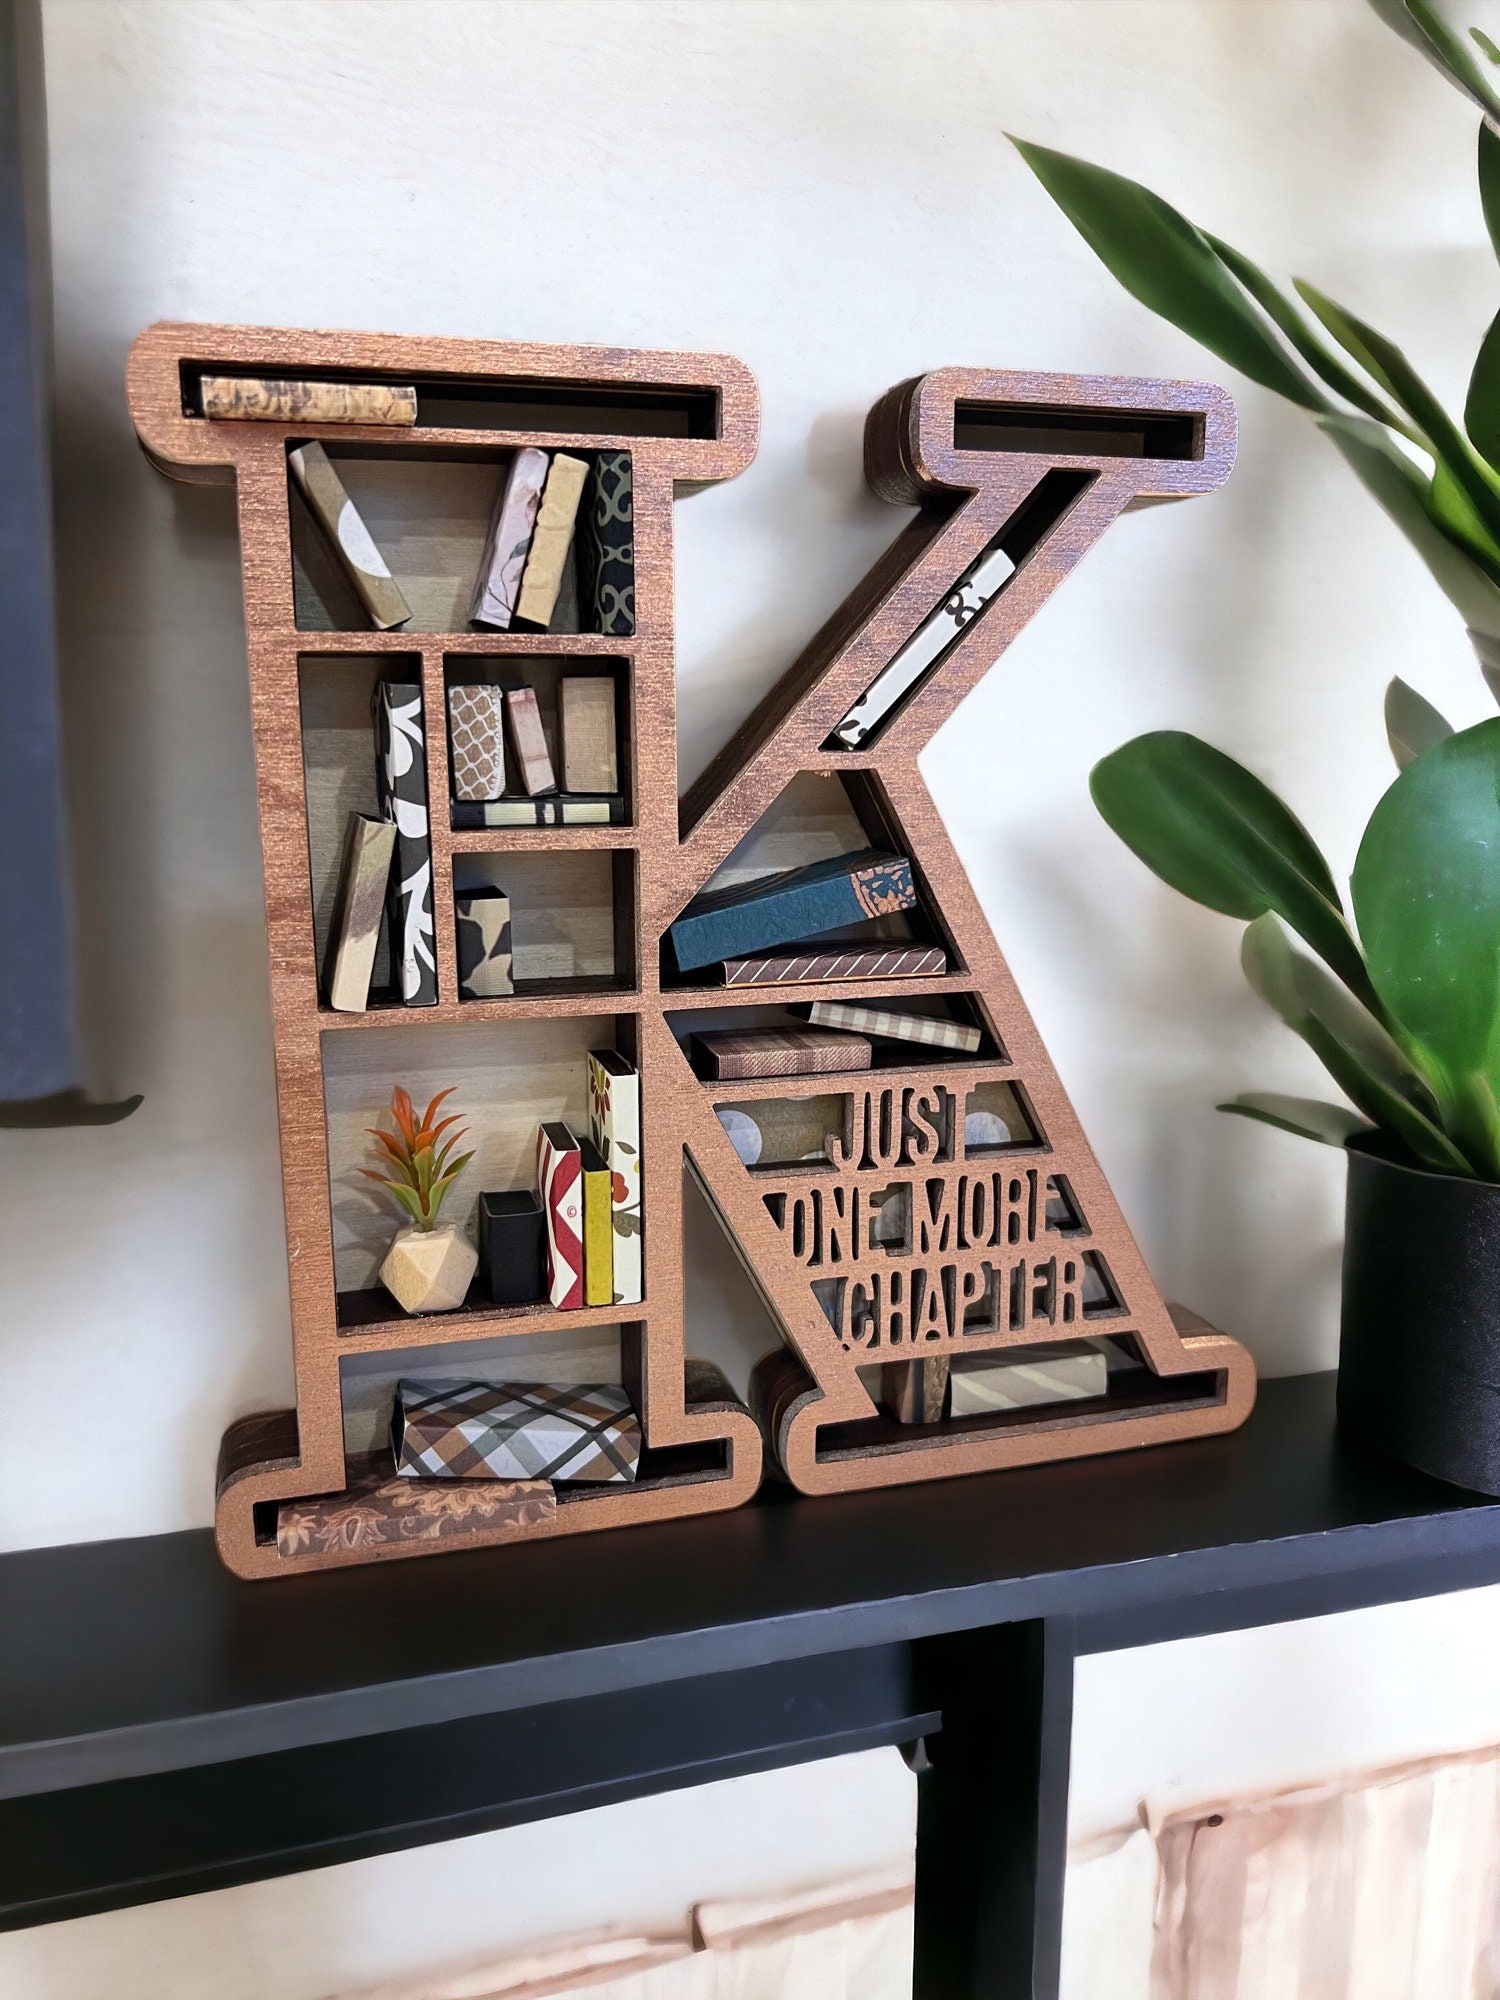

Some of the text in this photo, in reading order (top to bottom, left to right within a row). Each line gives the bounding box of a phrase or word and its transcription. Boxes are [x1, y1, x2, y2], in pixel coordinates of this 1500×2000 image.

[831, 1082, 976, 1171] JUST
[784, 1169, 1062, 1265] ONE MORE
[843, 1251, 1085, 1350] CHAPTER
